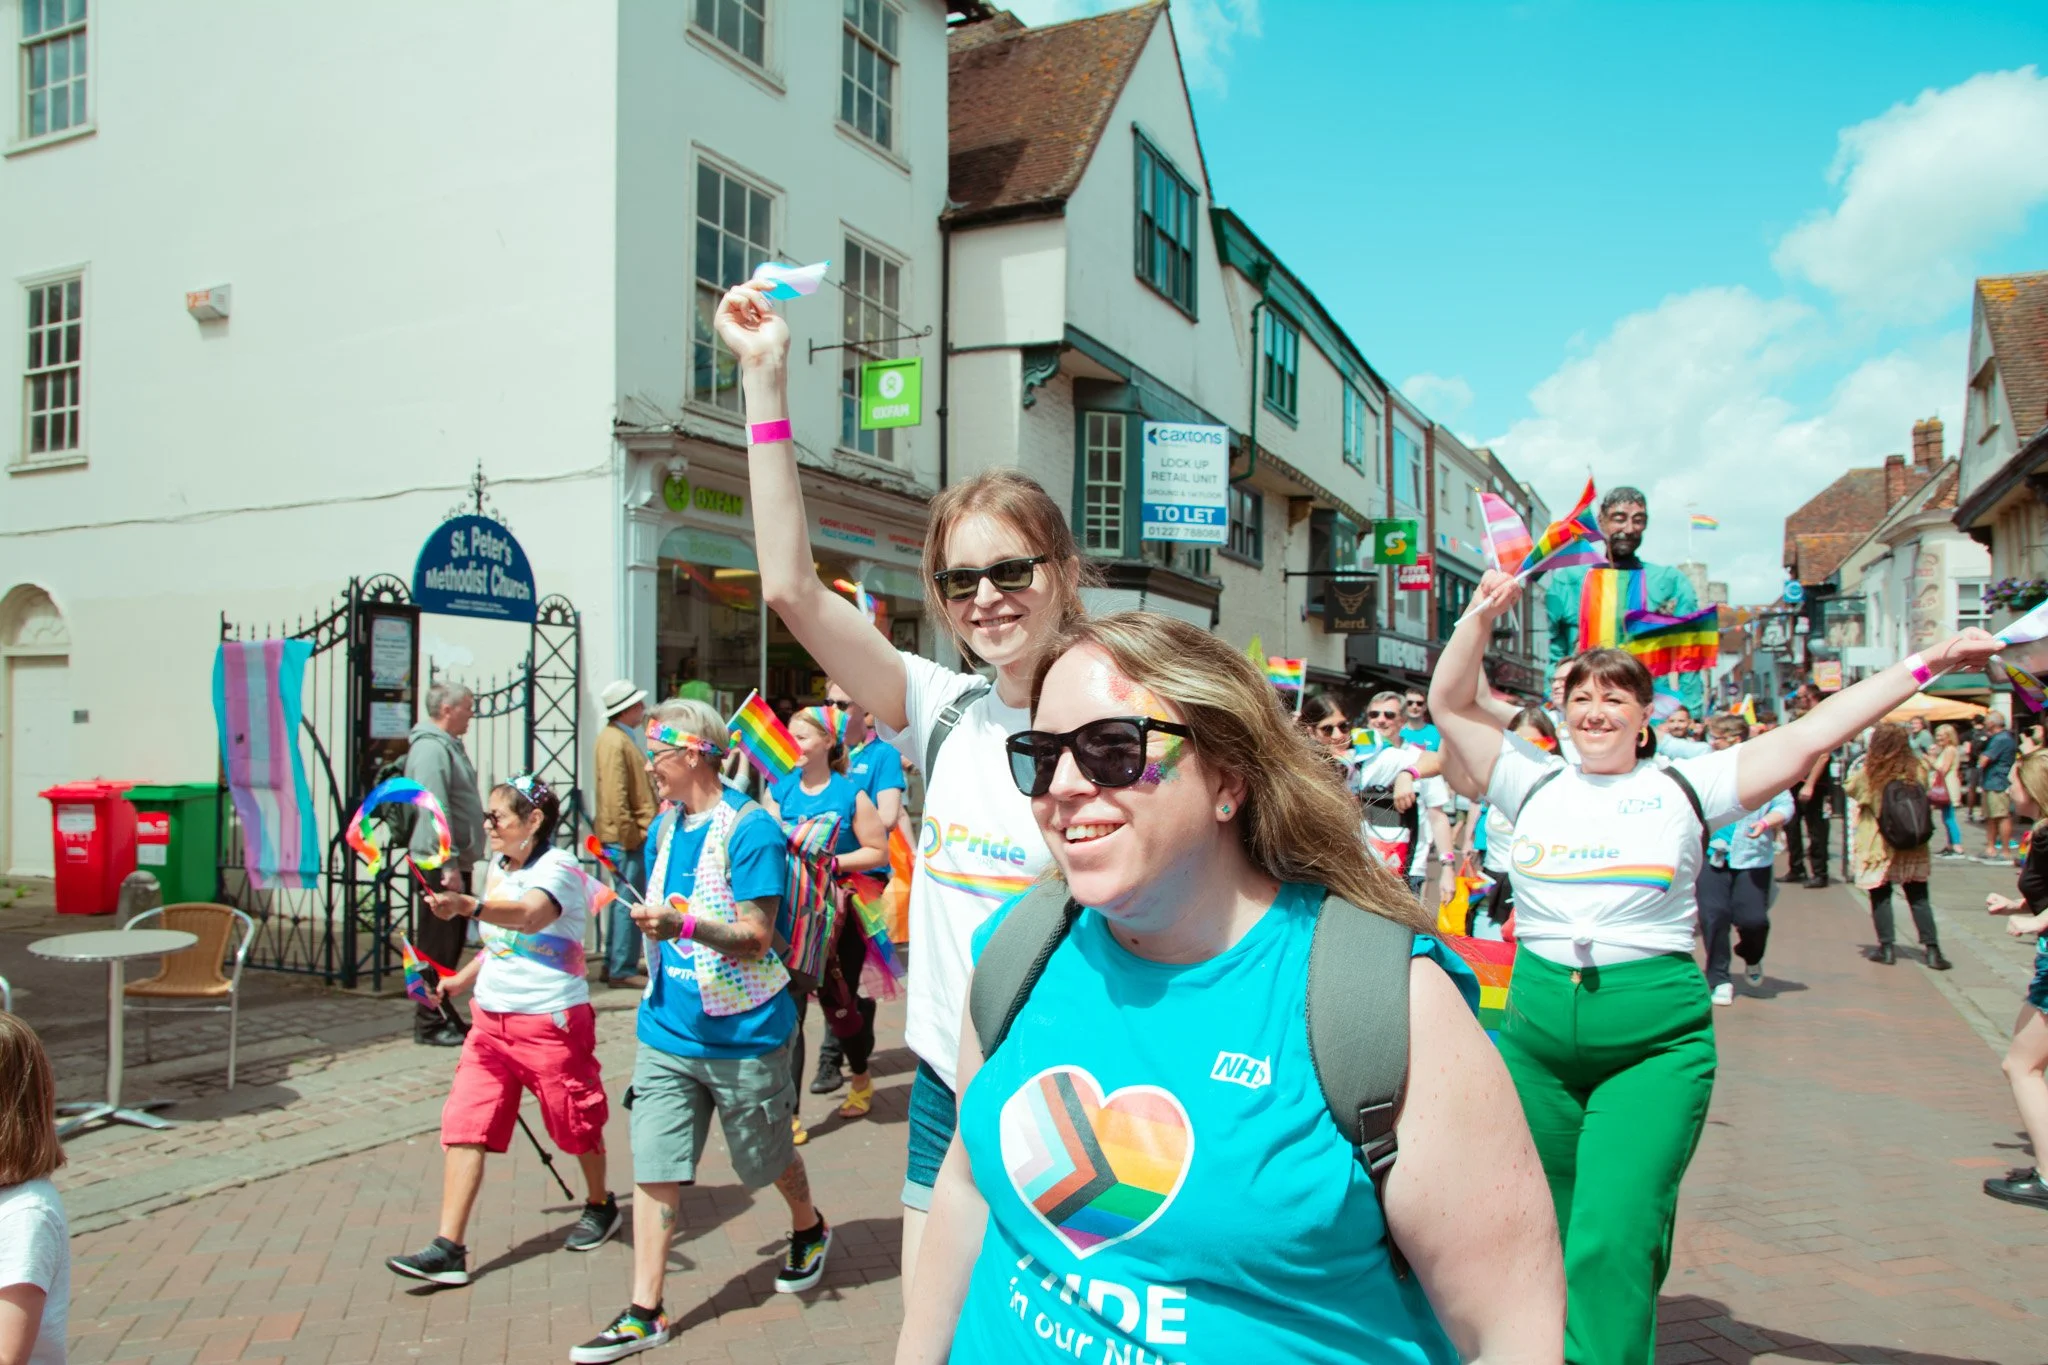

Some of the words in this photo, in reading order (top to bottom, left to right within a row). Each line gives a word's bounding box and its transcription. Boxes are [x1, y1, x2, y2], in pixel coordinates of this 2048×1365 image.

[872, 403, 910, 420] OXFAM
[1159, 429, 1222, 444] caxtons
[1160, 458, 1192, 469] LOCK
[1194, 460, 1209, 470] UP
[1151, 471, 1190, 483] RETAIL
[1192, 473, 1218, 484] UNIT
[695, 487, 743, 516] OXFAM
[1155, 505, 1180, 522] TO
[1183, 507, 1216, 524] LET
[1148, 526, 1180, 537] 01227
[450, 530, 468, 559] St.
[471, 525, 513, 566] Peter's
[425, 560, 488, 595] Methodist
[490, 564, 531, 600] Church
[945, 822, 1027, 866] Pride
[1549, 844, 1621, 859] Pride
[1009, 1276, 1029, 1321] in
[1034, 1311, 1094, 1359] our
[1102, 1337, 1187, 1365] NH
